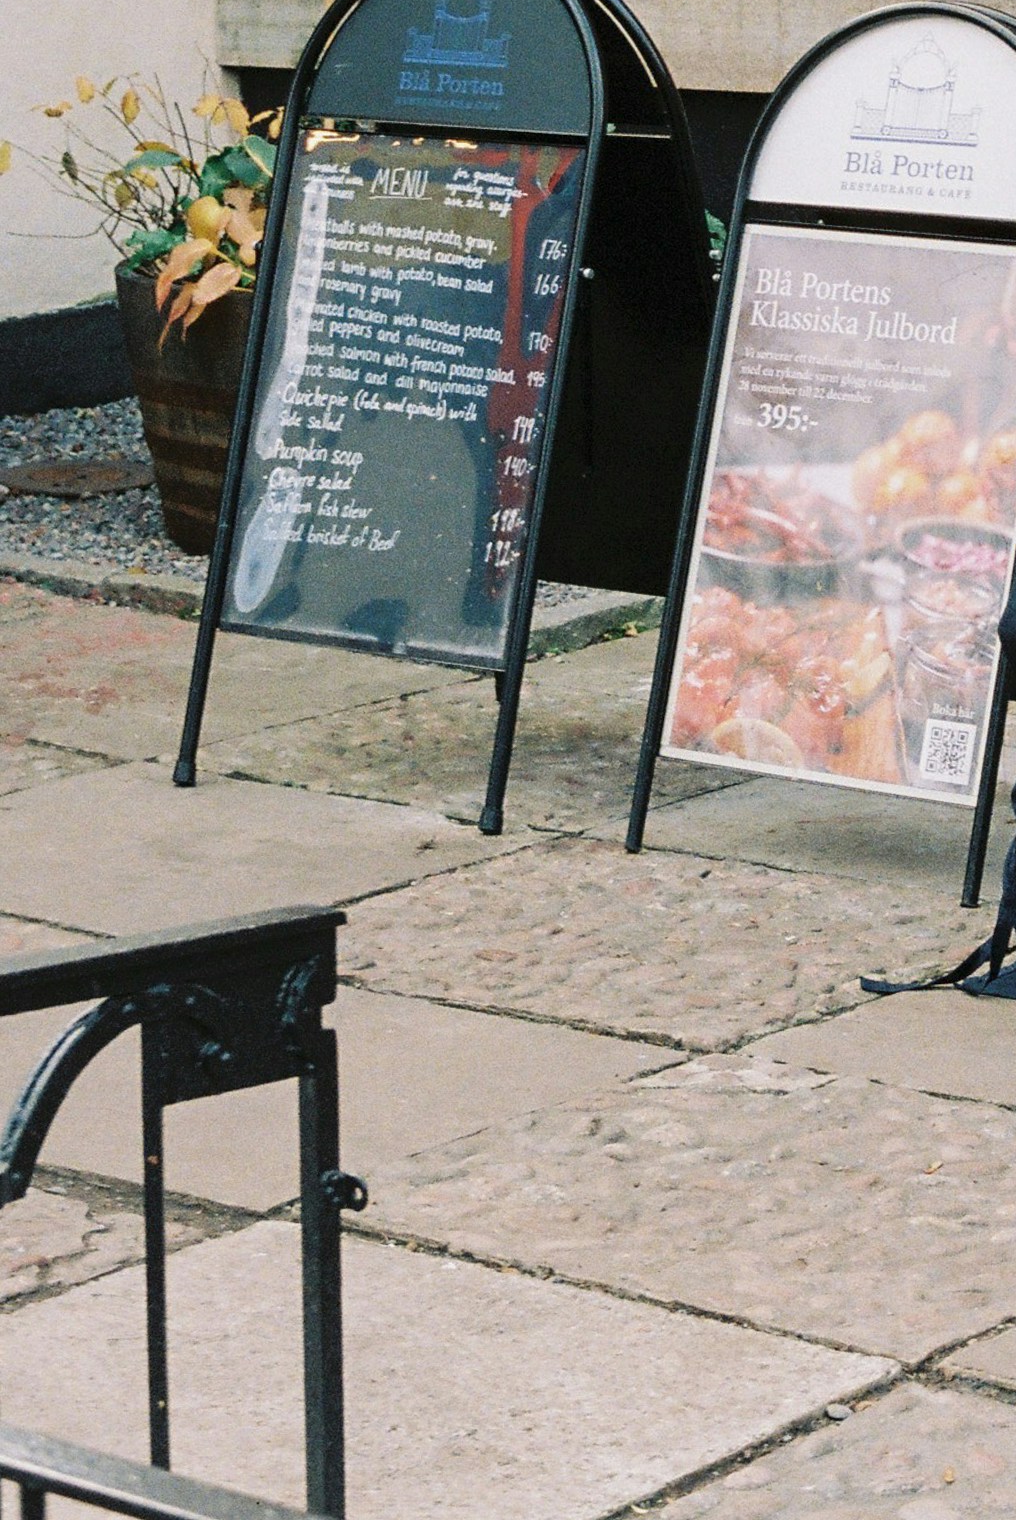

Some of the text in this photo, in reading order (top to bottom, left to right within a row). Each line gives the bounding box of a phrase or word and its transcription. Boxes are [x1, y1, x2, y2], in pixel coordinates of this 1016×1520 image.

[400, 70, 505, 96] Blå Porten
[843, 150, 974, 181] Blå Porten
[369, 166, 430, 198] MENU
[840, 181, 923, 196] RESTAURANG
[927, 187, 935, 196] &
[359, 221, 384, 237] with
[385, 225, 425, 240] mashed
[372, 243, 394, 255] and
[395, 245, 432, 262] pickled
[434, 249, 487, 269] cucumber
[342, 261, 367, 277] lamb
[368, 266, 393, 280] with
[396, 267, 437, 286] potato,
[436, 272, 462, 288] bean
[464, 278, 493, 294] salad
[755, 268, 892, 305] Blå Portens
[320, 278, 367, 301] rosemary
[370, 285, 402, 306] gravy
[329, 321, 374, 339] peppers
[377, 329, 401, 343] and
[346, 306, 388, 324] chicken
[392, 313, 418, 328] with
[421, 315, 461, 335] roasted
[463, 324, 503, 345] potato,
[750, 300, 958, 345] Klassiska Julbord
[340, 345, 381, 364] salmon
[383, 352, 409, 368] with
[410, 357, 447, 374] french
[449, 363, 484, 380] potato
[741, 364, 762, 375] med
[763, 368, 775, 377] en
[815, 374, 839, 383] varm
[744, 347, 755, 358] Vi
[756, 351, 793, 363] serverar
[793, 353, 806, 363] ett
[864, 359, 901, 373] julbord
[902, 365, 922, 373] som
[327, 366, 361, 382] salad
[363, 371, 388, 386] and
[394, 375, 413, 389] dill
[418, 378, 488, 398] mayonnaise
[751, 382, 798, 396] november
[798, 386, 813, 397] till
[814, 388, 827, 399] 22
[383, 396, 408, 412] and
[449, 401, 477, 421] with
[757, 402, 818, 432] 395:-
[274, 437, 363, 474] Pumpkin soup
[306, 524, 350, 545] brisket
[351, 526, 369, 547] of
